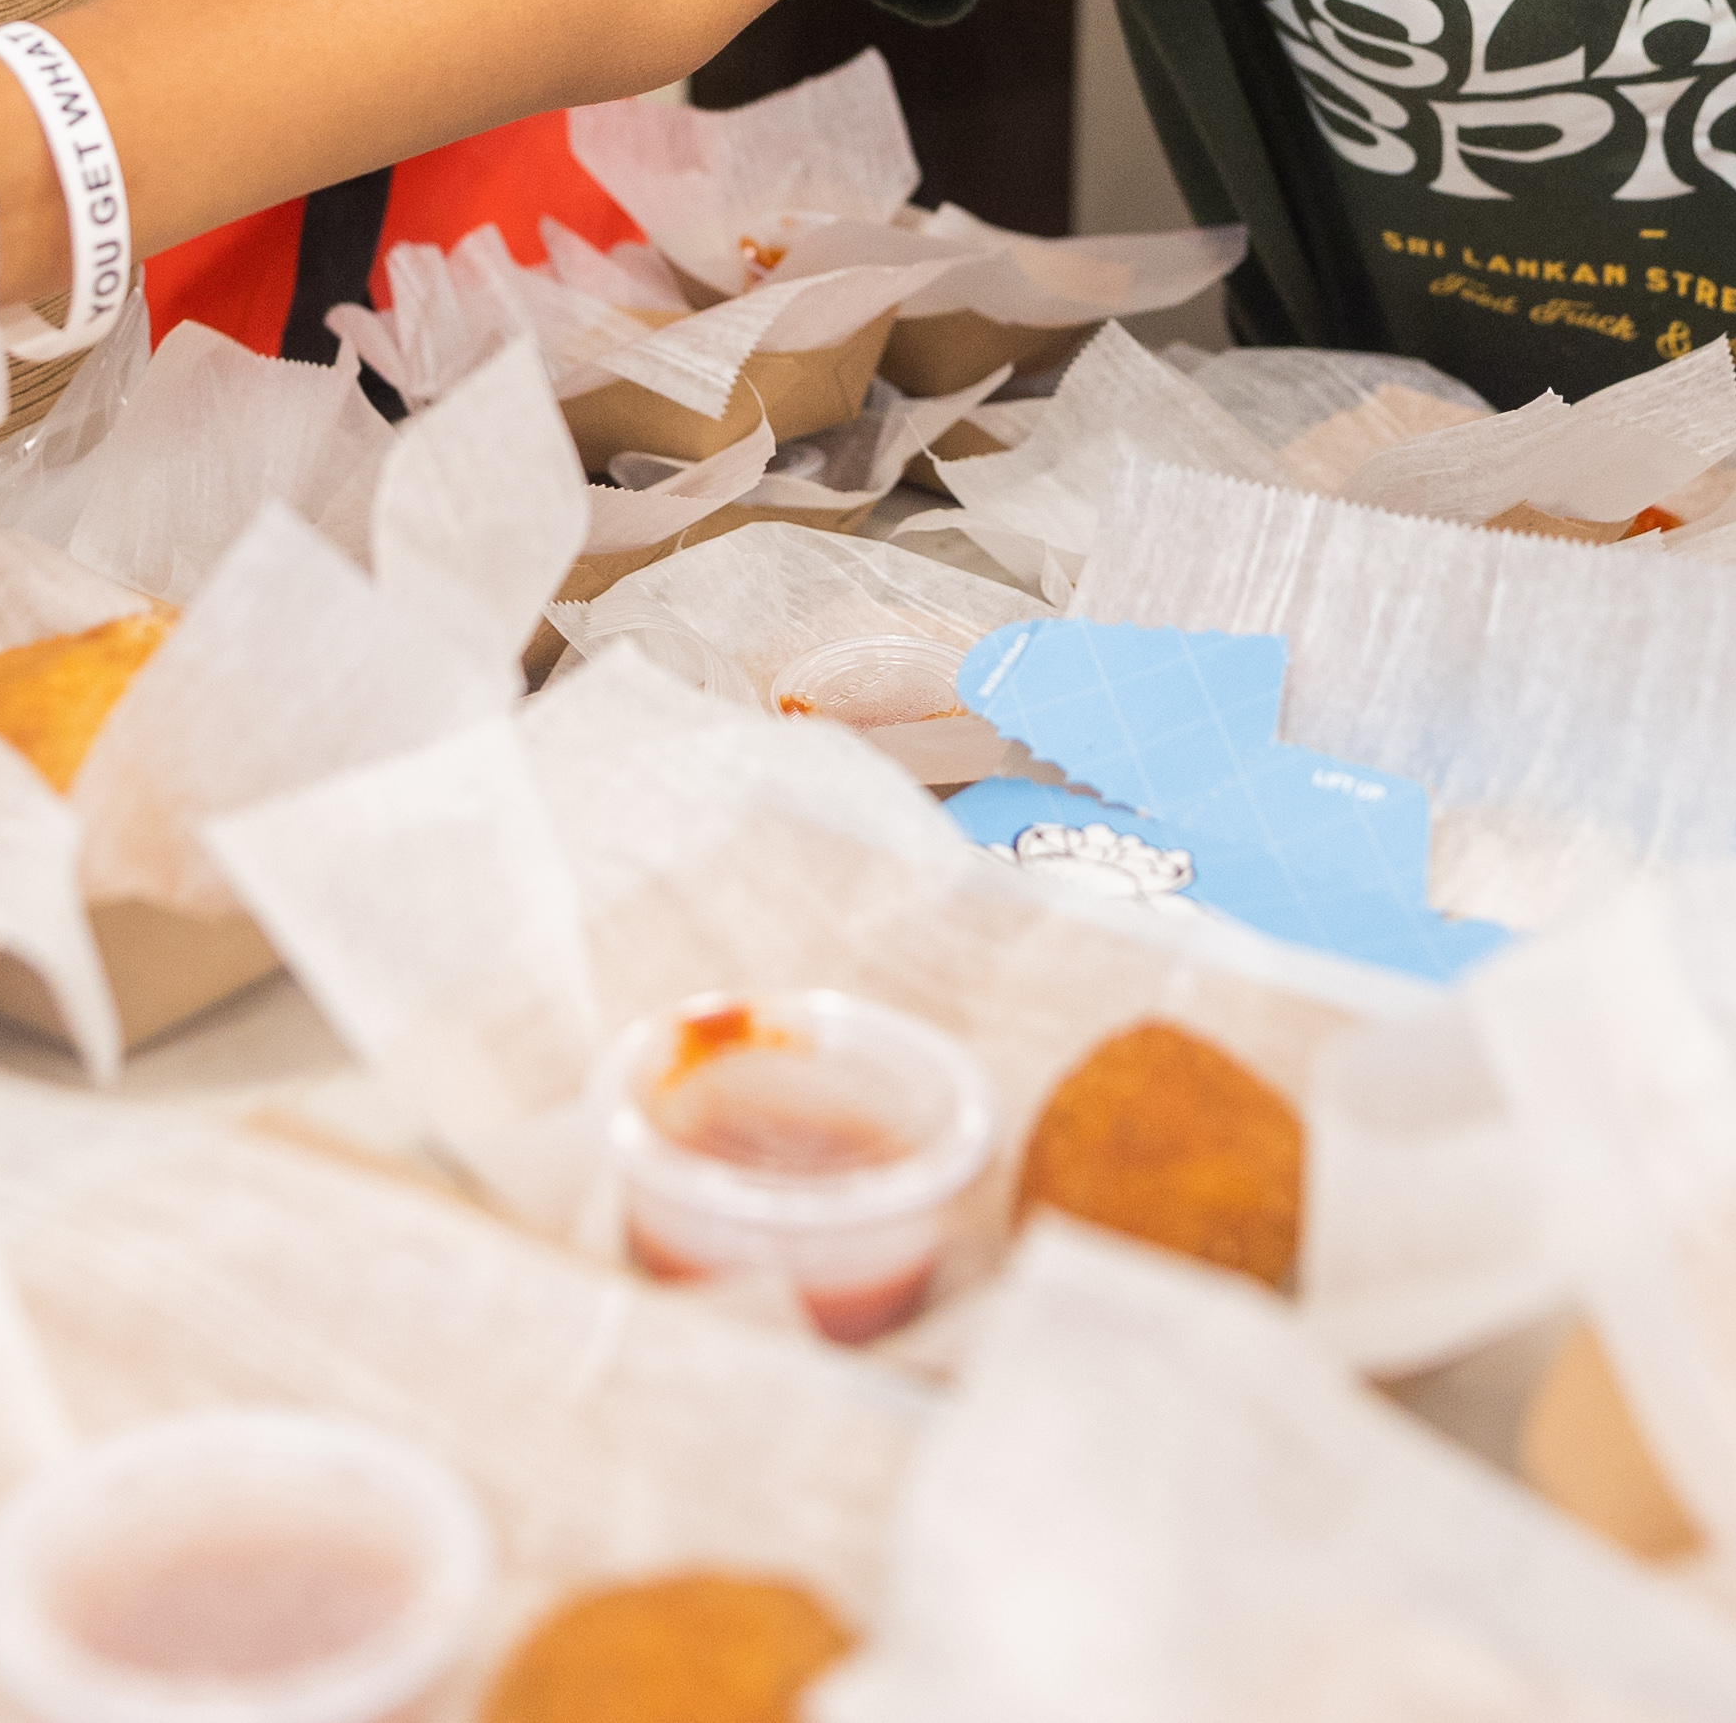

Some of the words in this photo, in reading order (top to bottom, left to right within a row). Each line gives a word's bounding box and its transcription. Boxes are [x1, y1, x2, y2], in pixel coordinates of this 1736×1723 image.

[5, 29, 90, 127] WHAT
[74, 140, 118, 226] GET
[89, 239, 122, 323] YOU
[1381, 229, 1445, 259] SRI
[1461, 245, 1627, 287] LANKAN
[1428, 272, 1517, 315] Food
[1529, 297, 1636, 342] Truck
[1655, 320, 1692, 359] &
[828, 665, 895, 708] SOLO
